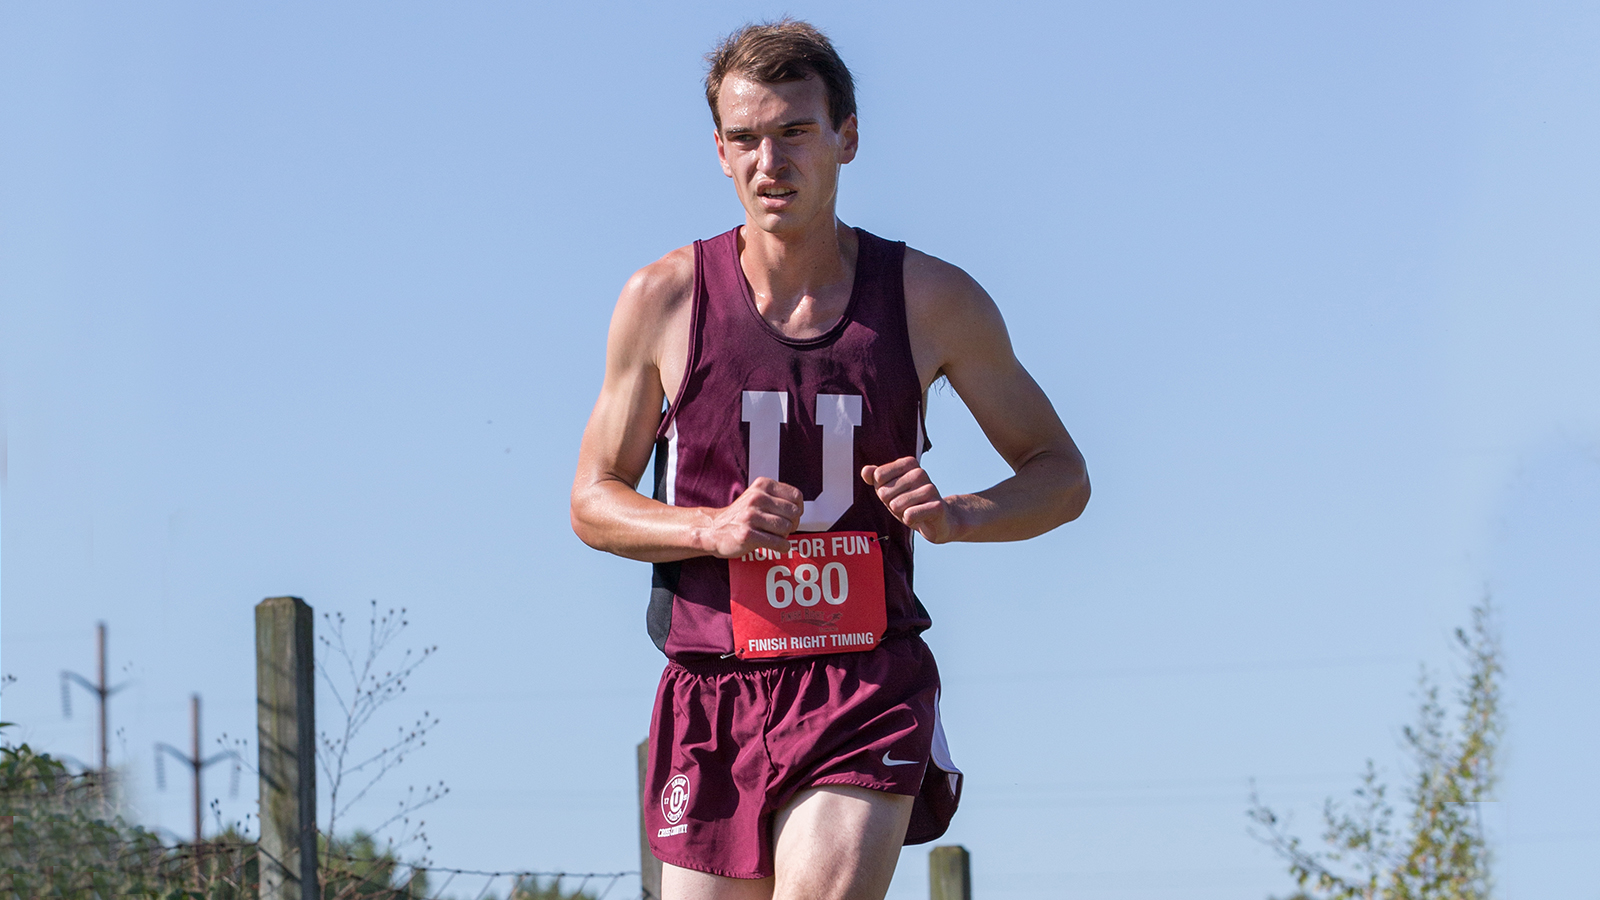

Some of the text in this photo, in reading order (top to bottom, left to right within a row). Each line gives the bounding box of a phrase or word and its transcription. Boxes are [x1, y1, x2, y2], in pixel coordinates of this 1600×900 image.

[742, 391, 862, 532] U
[788, 538, 826, 559] FOR
[832, 536, 870, 556] FUN
[766, 562, 849, 609] 680
[749, 632, 874, 652] FINISH RIGHT TIMING
